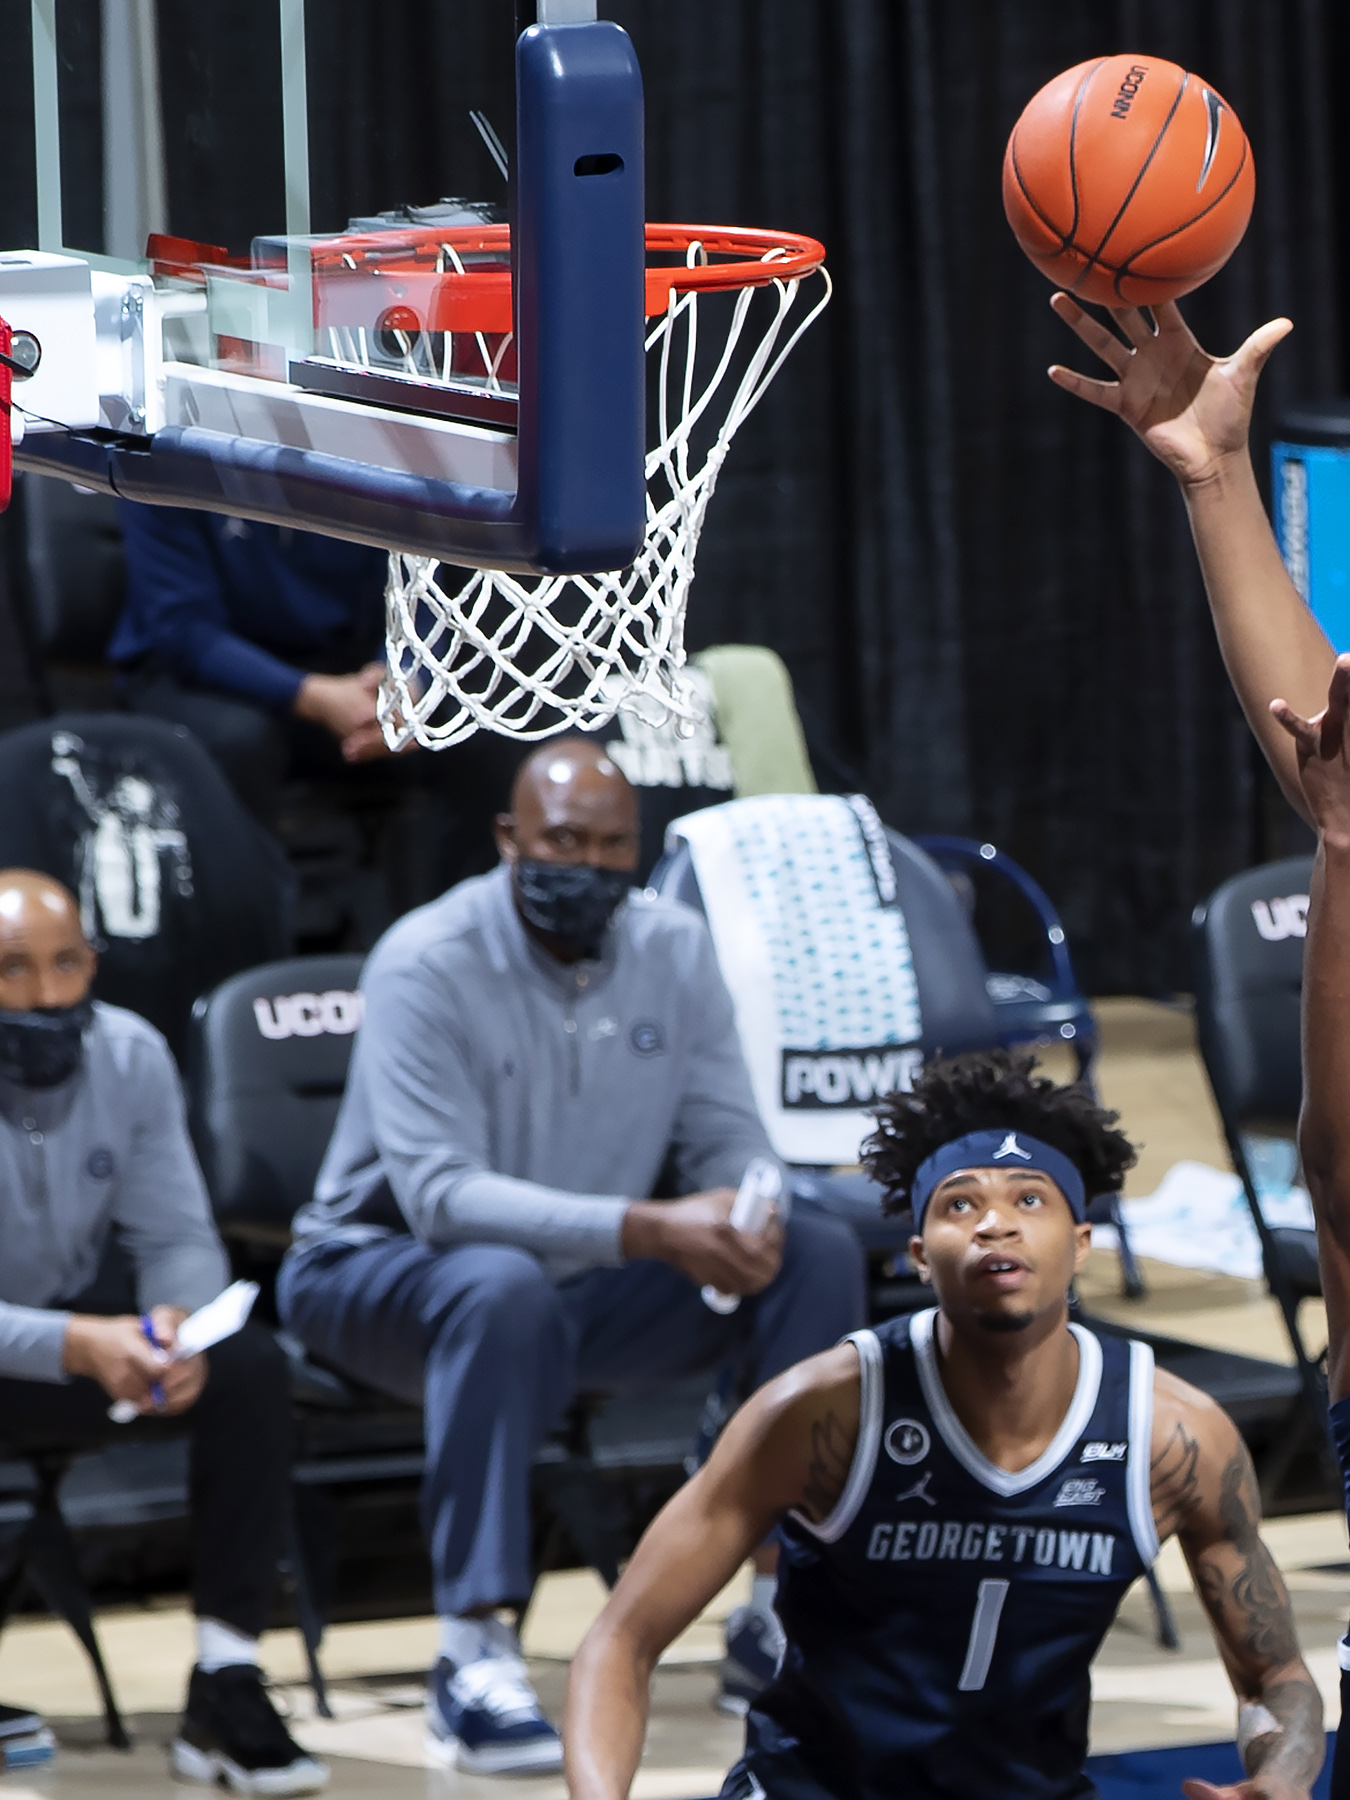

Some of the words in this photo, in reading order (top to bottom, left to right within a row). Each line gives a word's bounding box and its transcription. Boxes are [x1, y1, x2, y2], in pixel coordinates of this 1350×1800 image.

[1110, 65, 1149, 120] UCONN
[252, 990, 364, 1039] UCO
[1081, 1441, 1127, 1460] BLM
[1055, 1488, 1106, 1504] EAST
[1061, 1478, 1099, 1493] BIG
[866, 1520, 1115, 1576] GEORGETOWN
[957, 1578, 1010, 1691] 1
